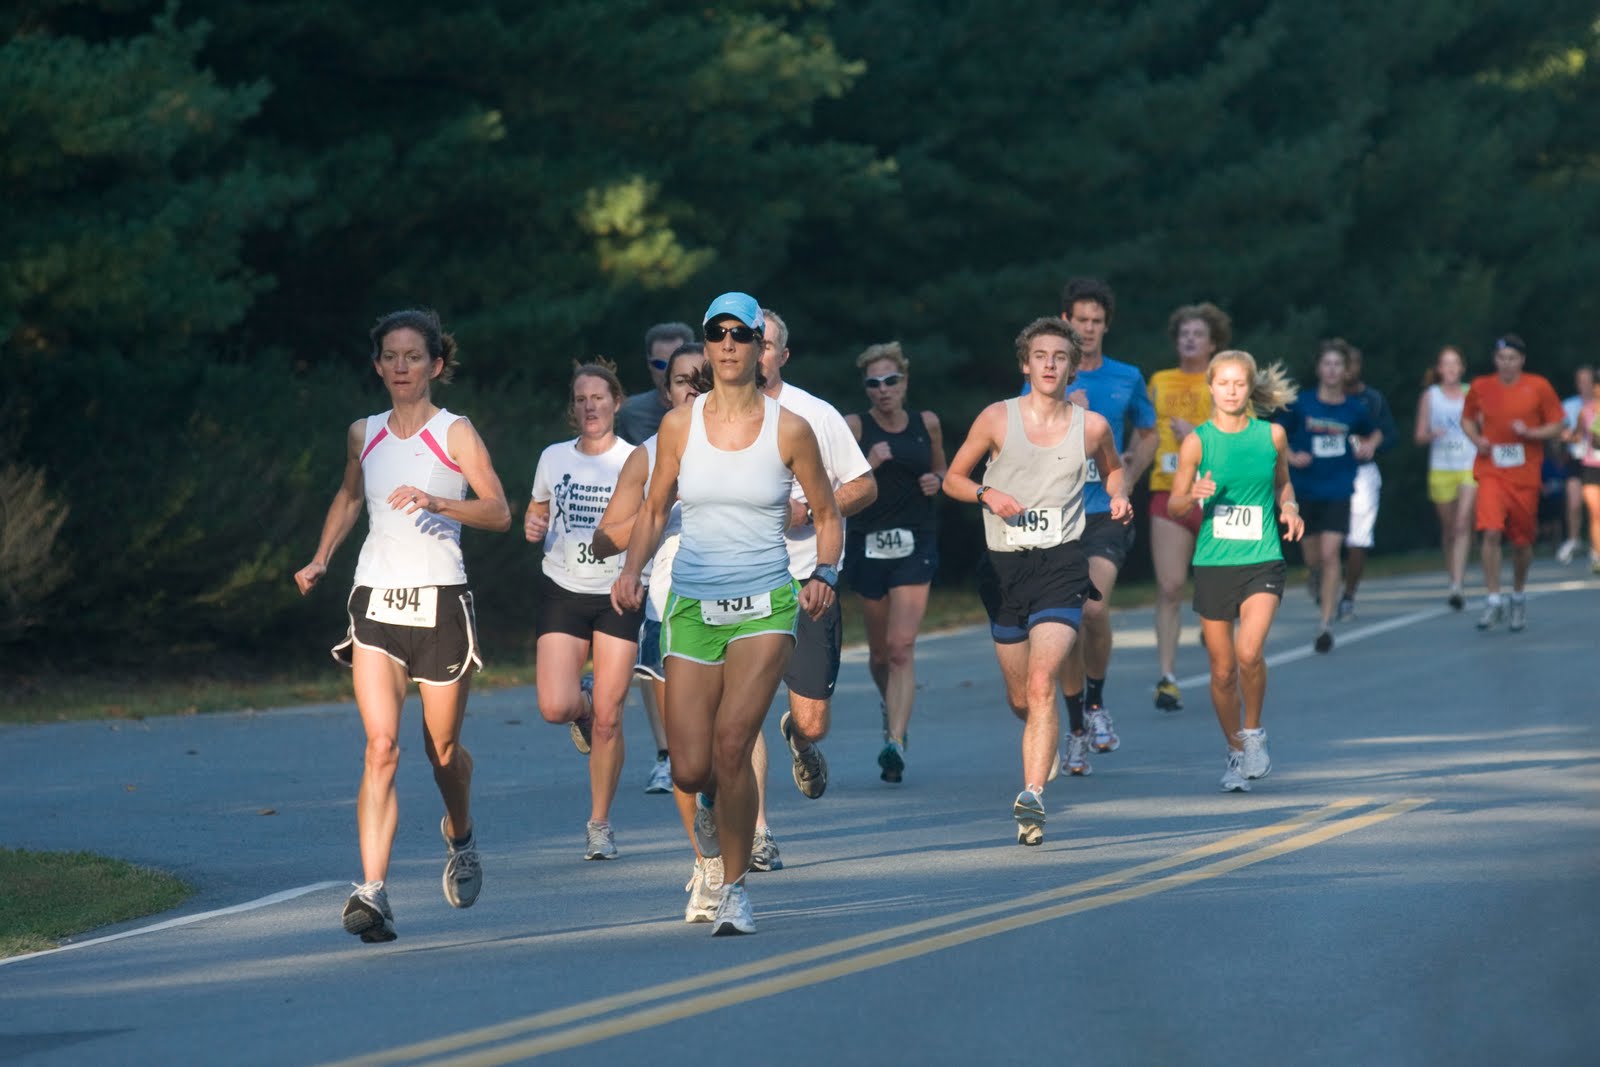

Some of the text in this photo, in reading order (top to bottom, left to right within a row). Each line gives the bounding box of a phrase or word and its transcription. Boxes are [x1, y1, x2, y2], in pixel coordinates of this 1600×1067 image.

[571, 483, 612, 493] Ragged
[569, 514, 596, 524] Shop
[1017, 509, 1049, 532] 495
[1226, 507, 1251, 526] 270
[876, 531, 902, 549] 544
[577, 542, 606, 565] 39
[383, 588, 421, 612] 494
